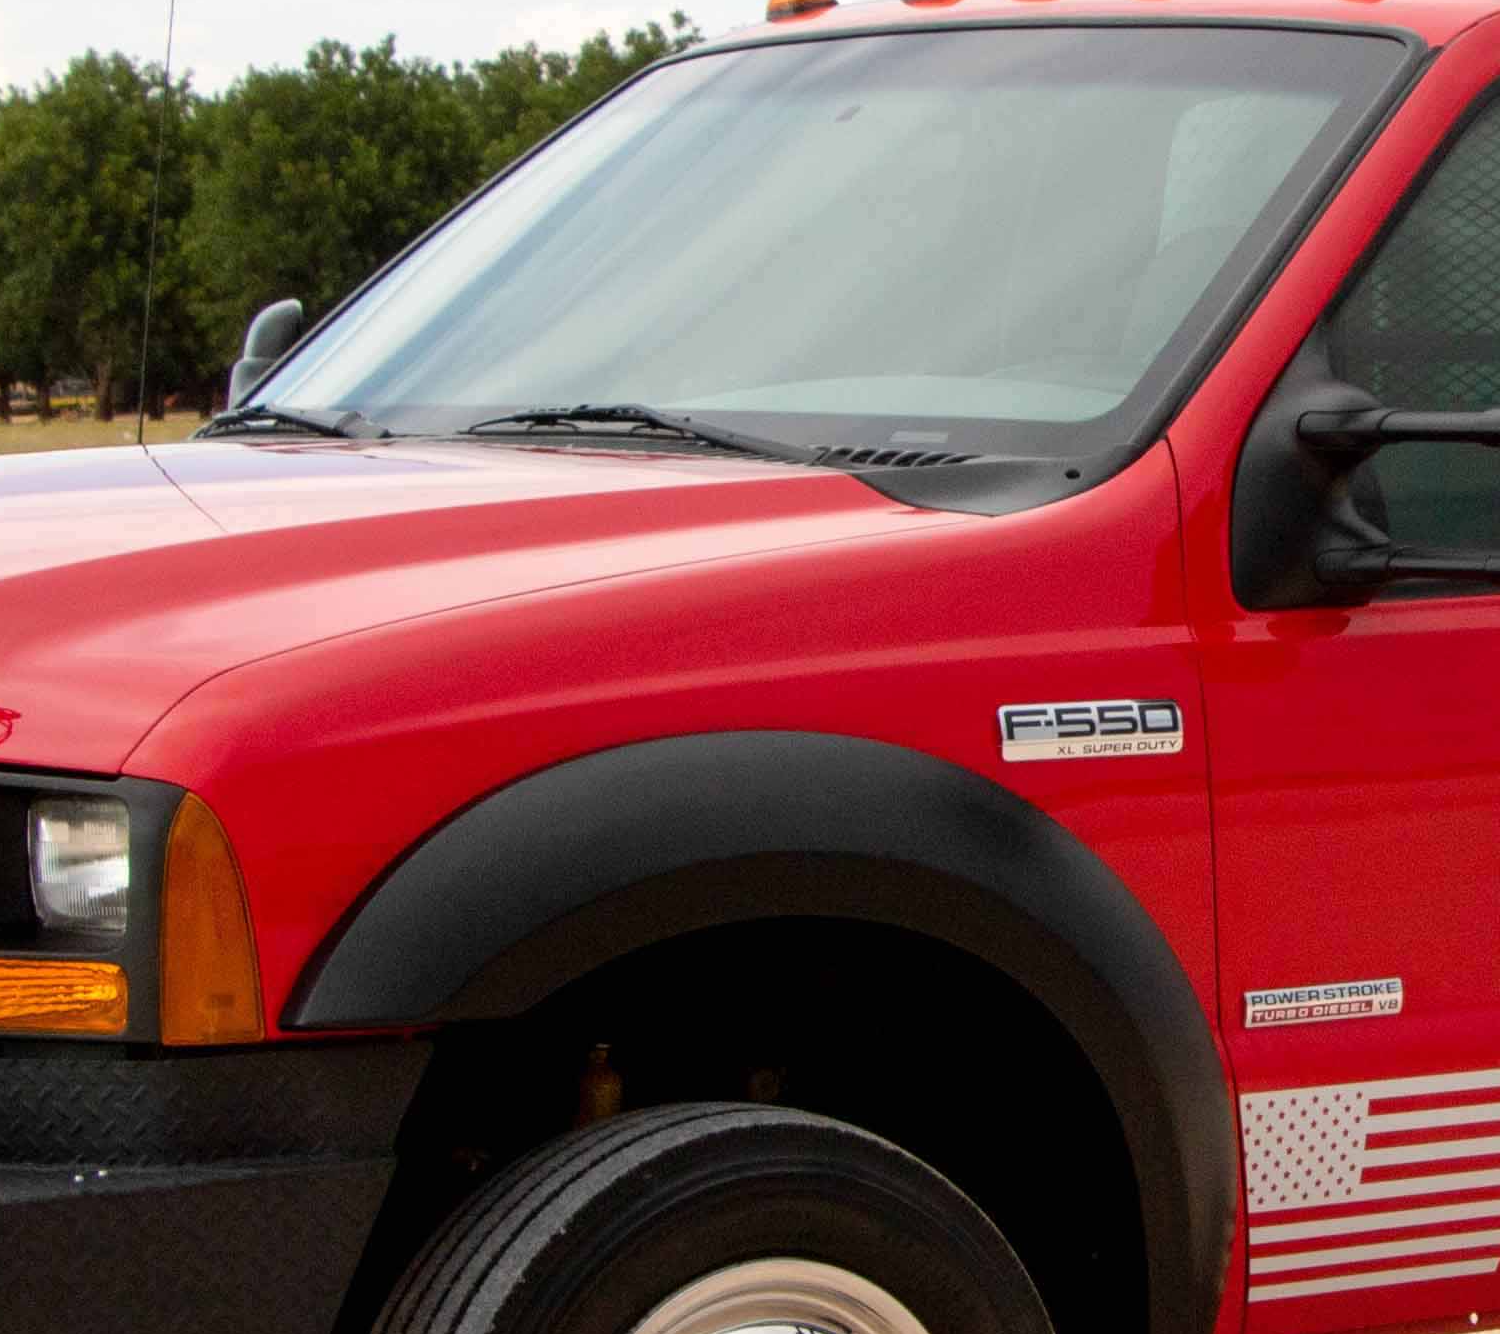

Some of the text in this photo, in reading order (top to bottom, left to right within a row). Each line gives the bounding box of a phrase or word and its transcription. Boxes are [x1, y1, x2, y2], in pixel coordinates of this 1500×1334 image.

[1003, 703, 1180, 740] F-550
[1057, 739, 1179, 756] XL SUPER DUTY
[1251, 980, 1400, 1007] POWER STROKE
[1253, 999, 1399, 1022] TURBO DIESEL V8
